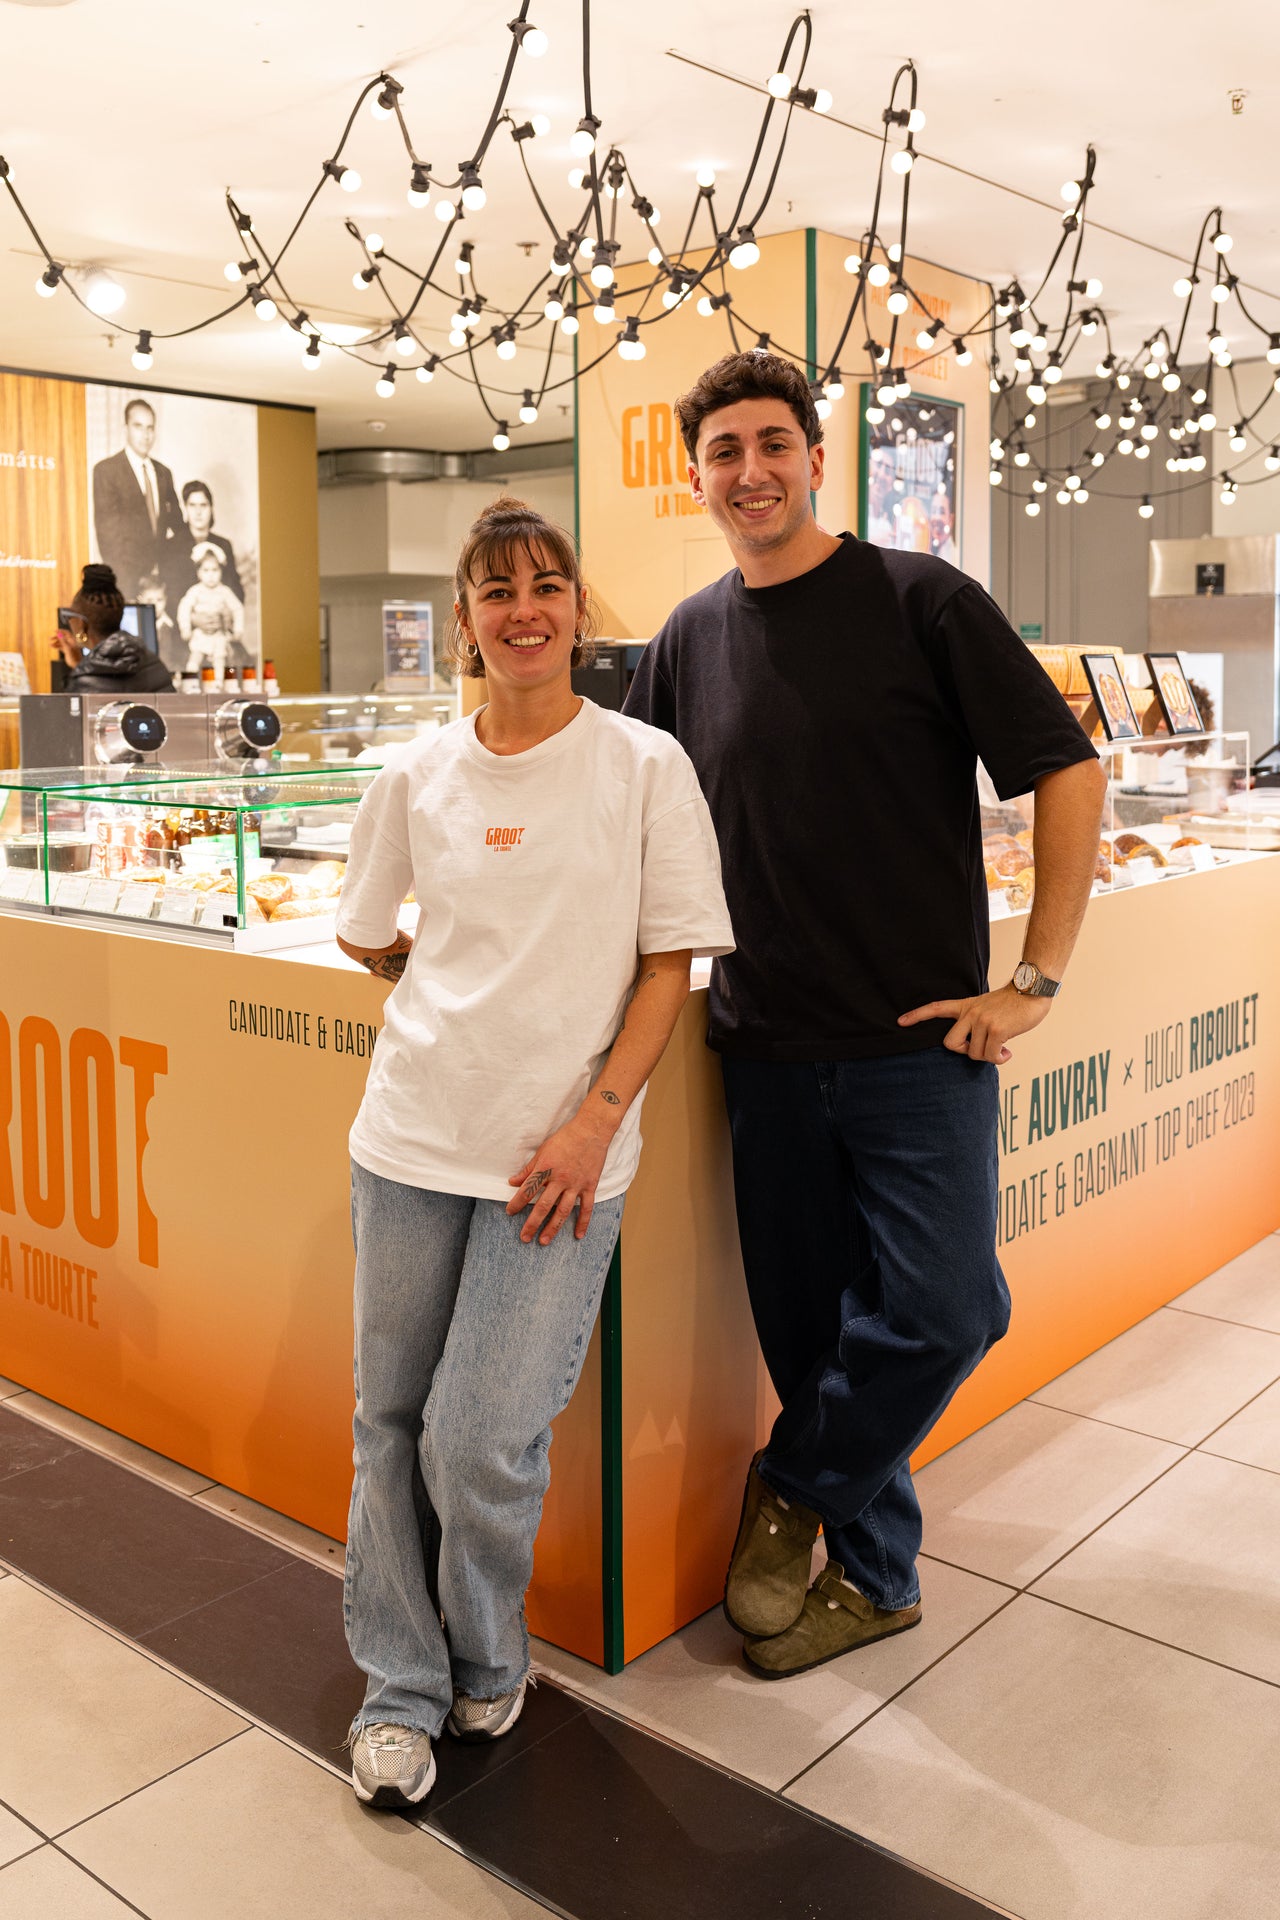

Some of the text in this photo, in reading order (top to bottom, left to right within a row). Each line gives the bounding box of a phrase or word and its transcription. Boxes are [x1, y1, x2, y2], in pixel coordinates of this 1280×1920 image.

[655, 494, 670, 518] LA
[485, 827, 525, 845] GROOT
[229, 1000, 311, 1046] CANDIDATE
[317, 1016, 327, 1049] &
[1028, 1049, 1111, 1146] AUVRAY
[1145, 1022, 1183, 1093] HUGO
[1189, 992, 1258, 1073] RIBOULET
[1055, 1162, 1066, 1217] &
[1074, 1122, 1148, 1208] GAGNANT
[1155, 1107, 1180, 1165] TOP
[1186, 1088, 1219, 1149] CHEF
[1224, 1072, 1254, 1130] 2023
[20, 1242, 99, 1329] TOURTE
